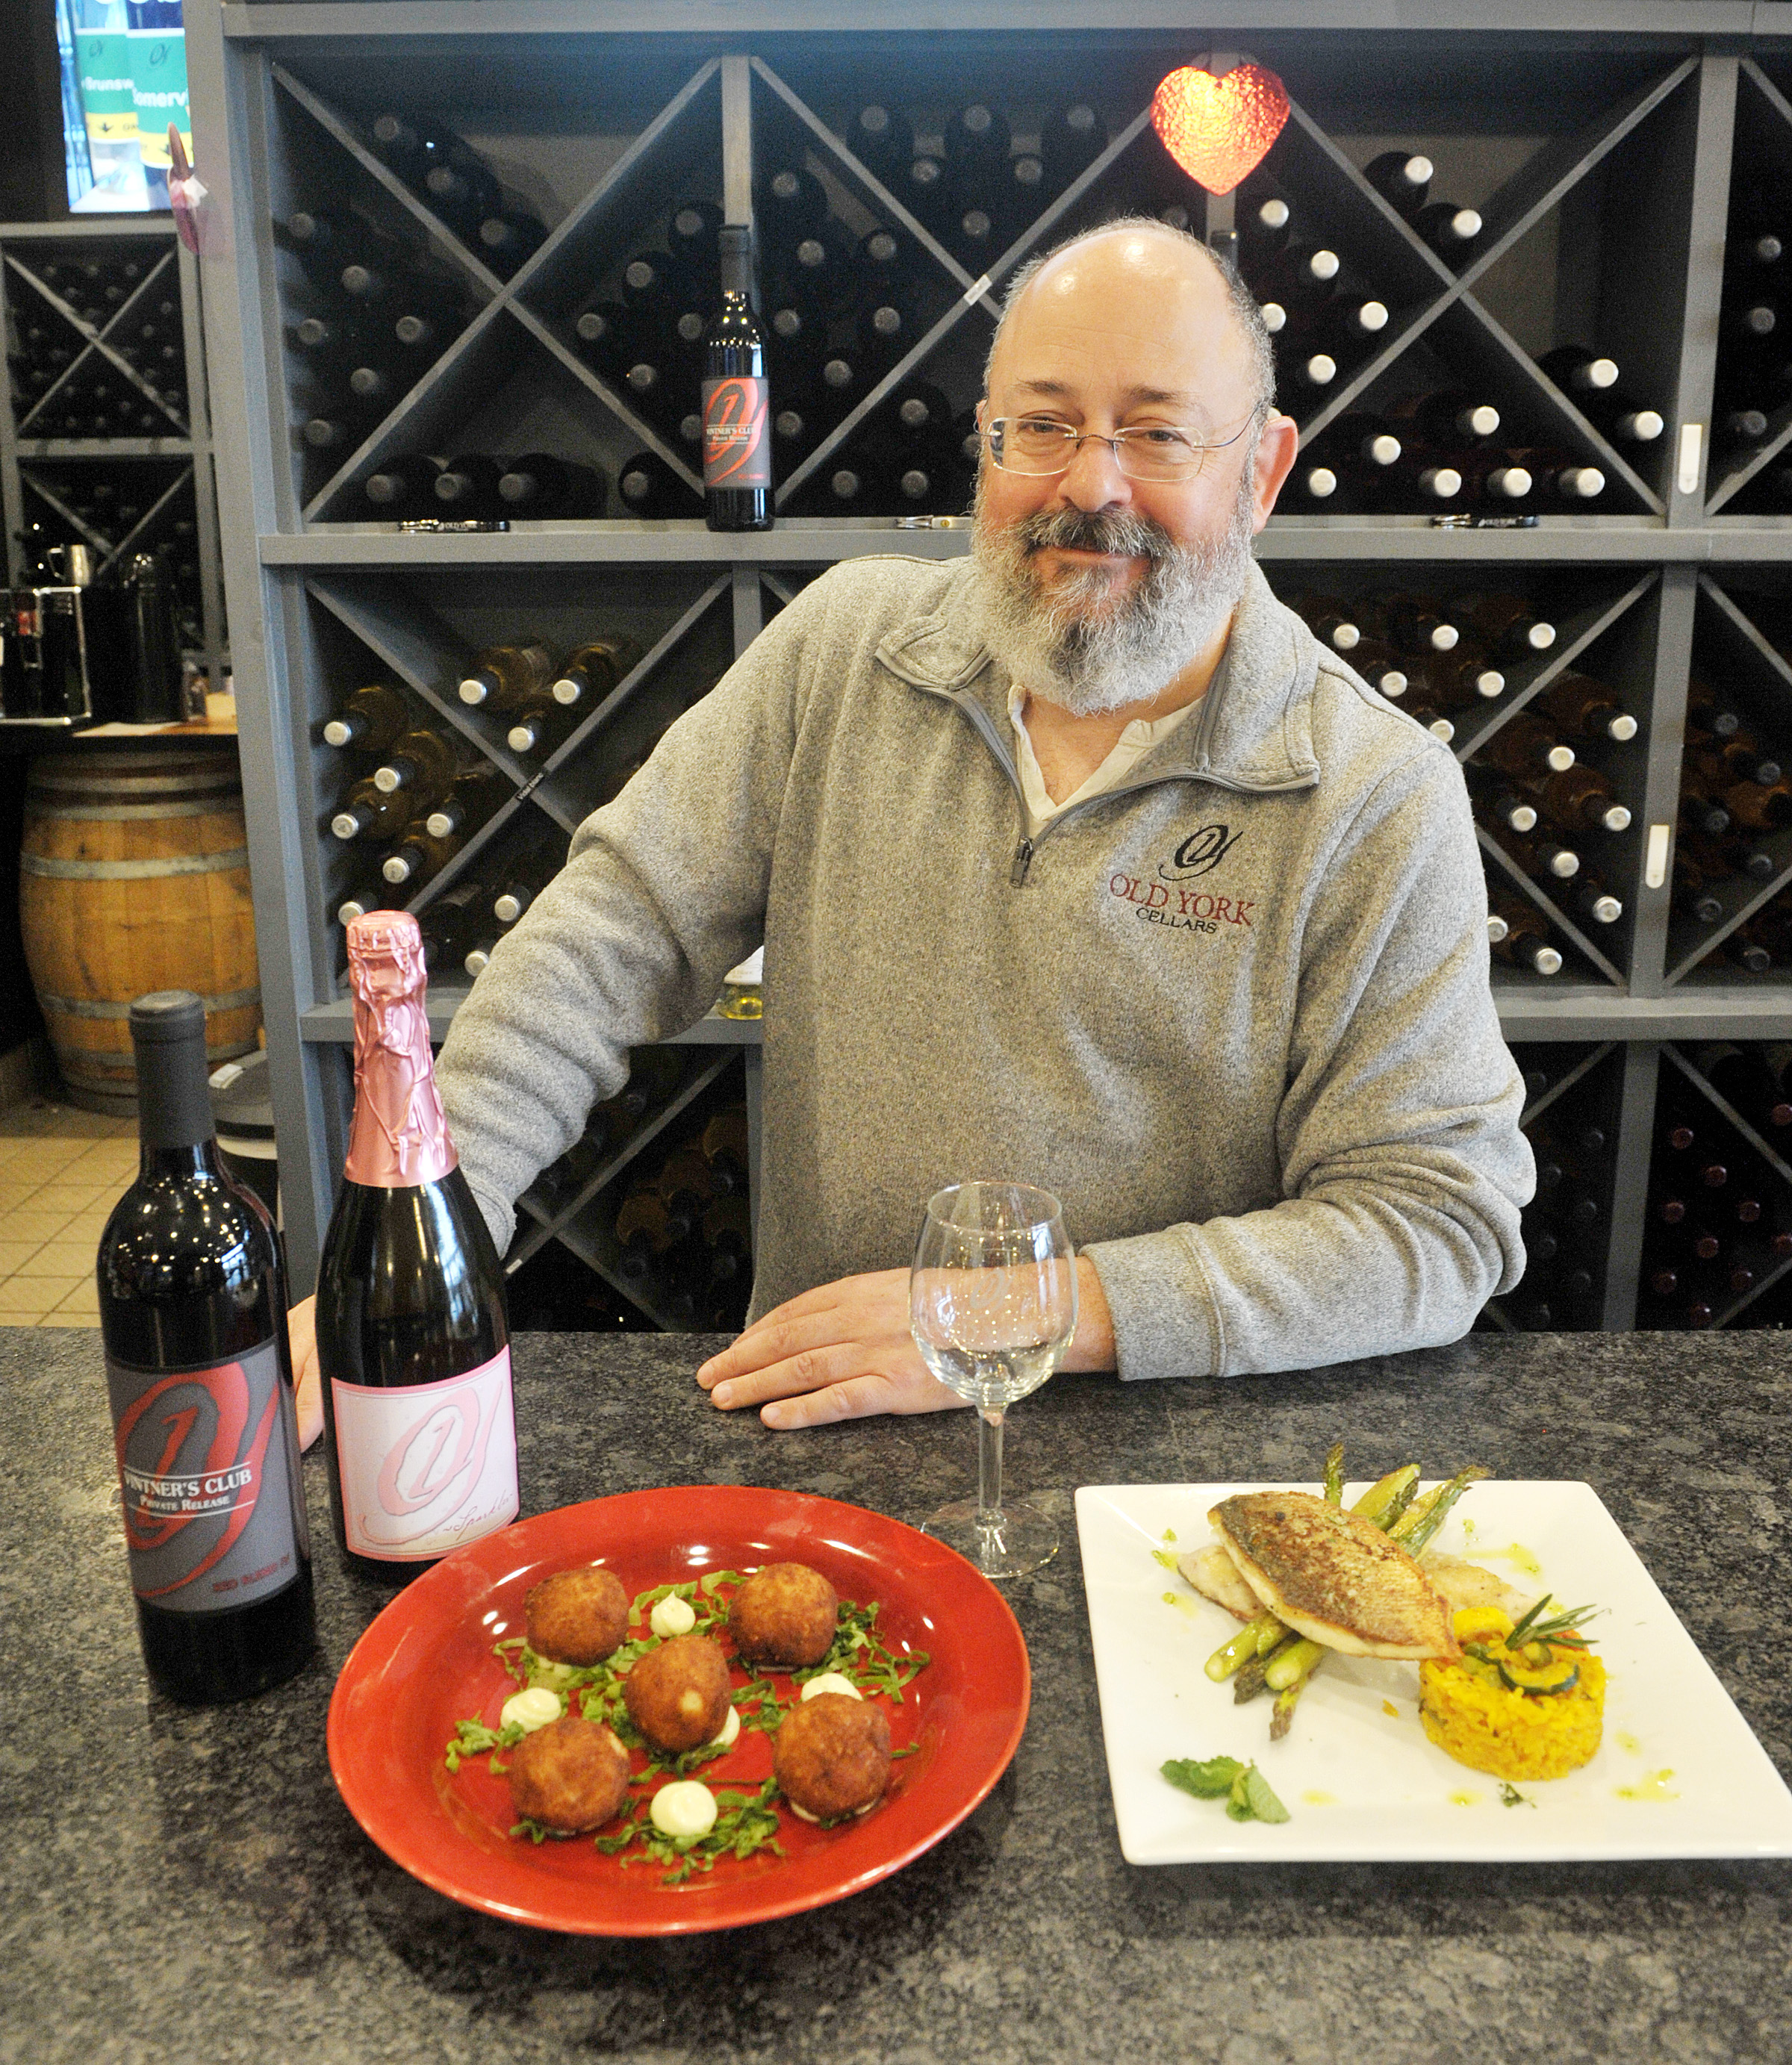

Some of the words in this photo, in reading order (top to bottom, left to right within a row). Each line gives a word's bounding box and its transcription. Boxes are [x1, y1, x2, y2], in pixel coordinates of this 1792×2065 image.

[1110, 873, 1169, 908] OLD
[1177, 888, 1254, 926] YORK
[1136, 908, 1218, 933] CELLARS
[205, 1468, 252, 1494] CLUB
